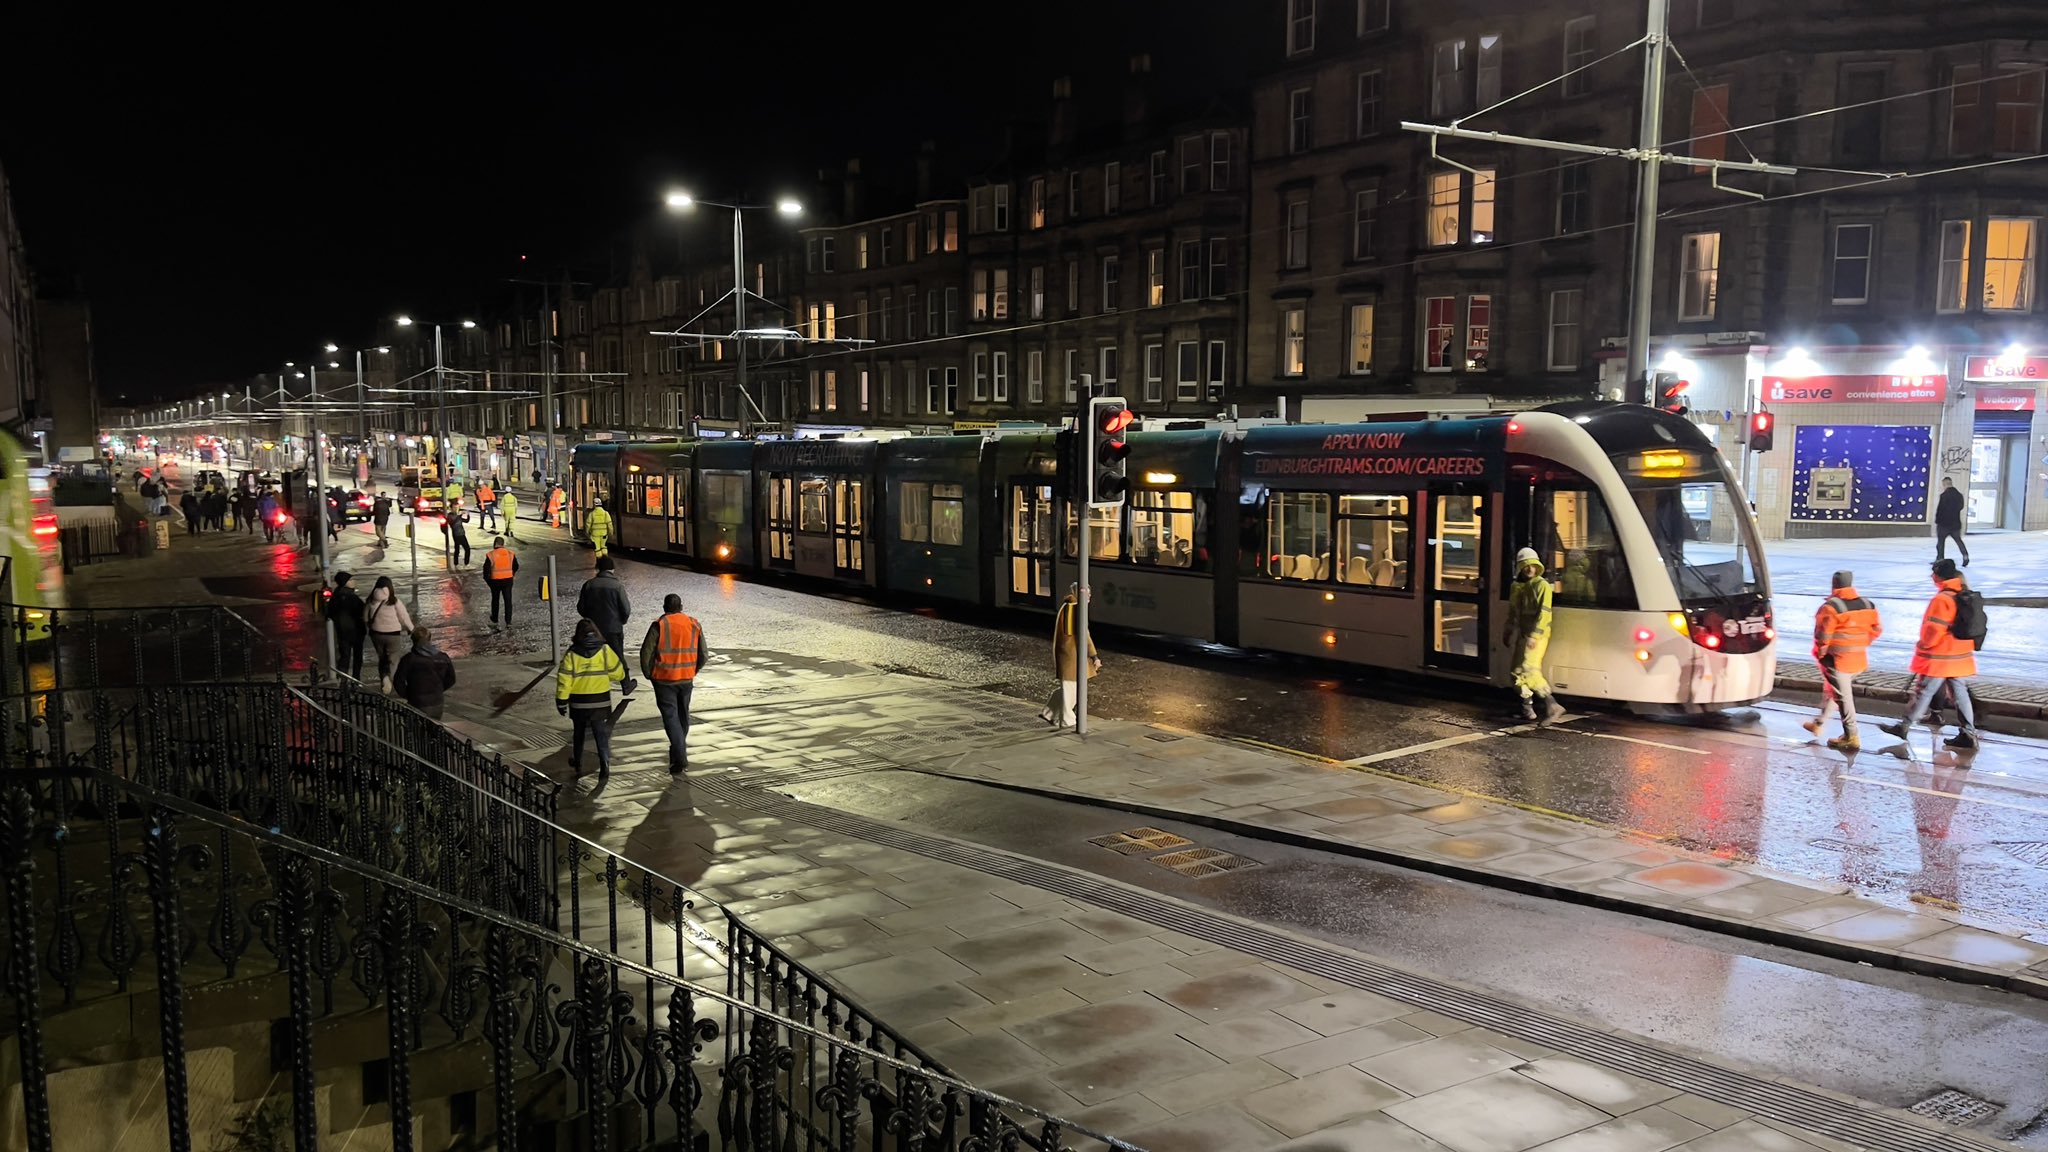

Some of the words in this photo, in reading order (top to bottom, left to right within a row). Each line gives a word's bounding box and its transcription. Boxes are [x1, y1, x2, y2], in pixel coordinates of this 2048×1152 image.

[1846, 390, 1909, 399] convenience
[1910, 388, 1936, 398] store
[1983, 395, 2027, 404] welcome
[1322, 433, 1367, 450] APPLY
[1367, 432, 1405, 449] NOW
[769, 446, 796, 466] NOW
[1255, 457, 1486, 475] EDINBURGHTRAMS.COM/CAREERS
